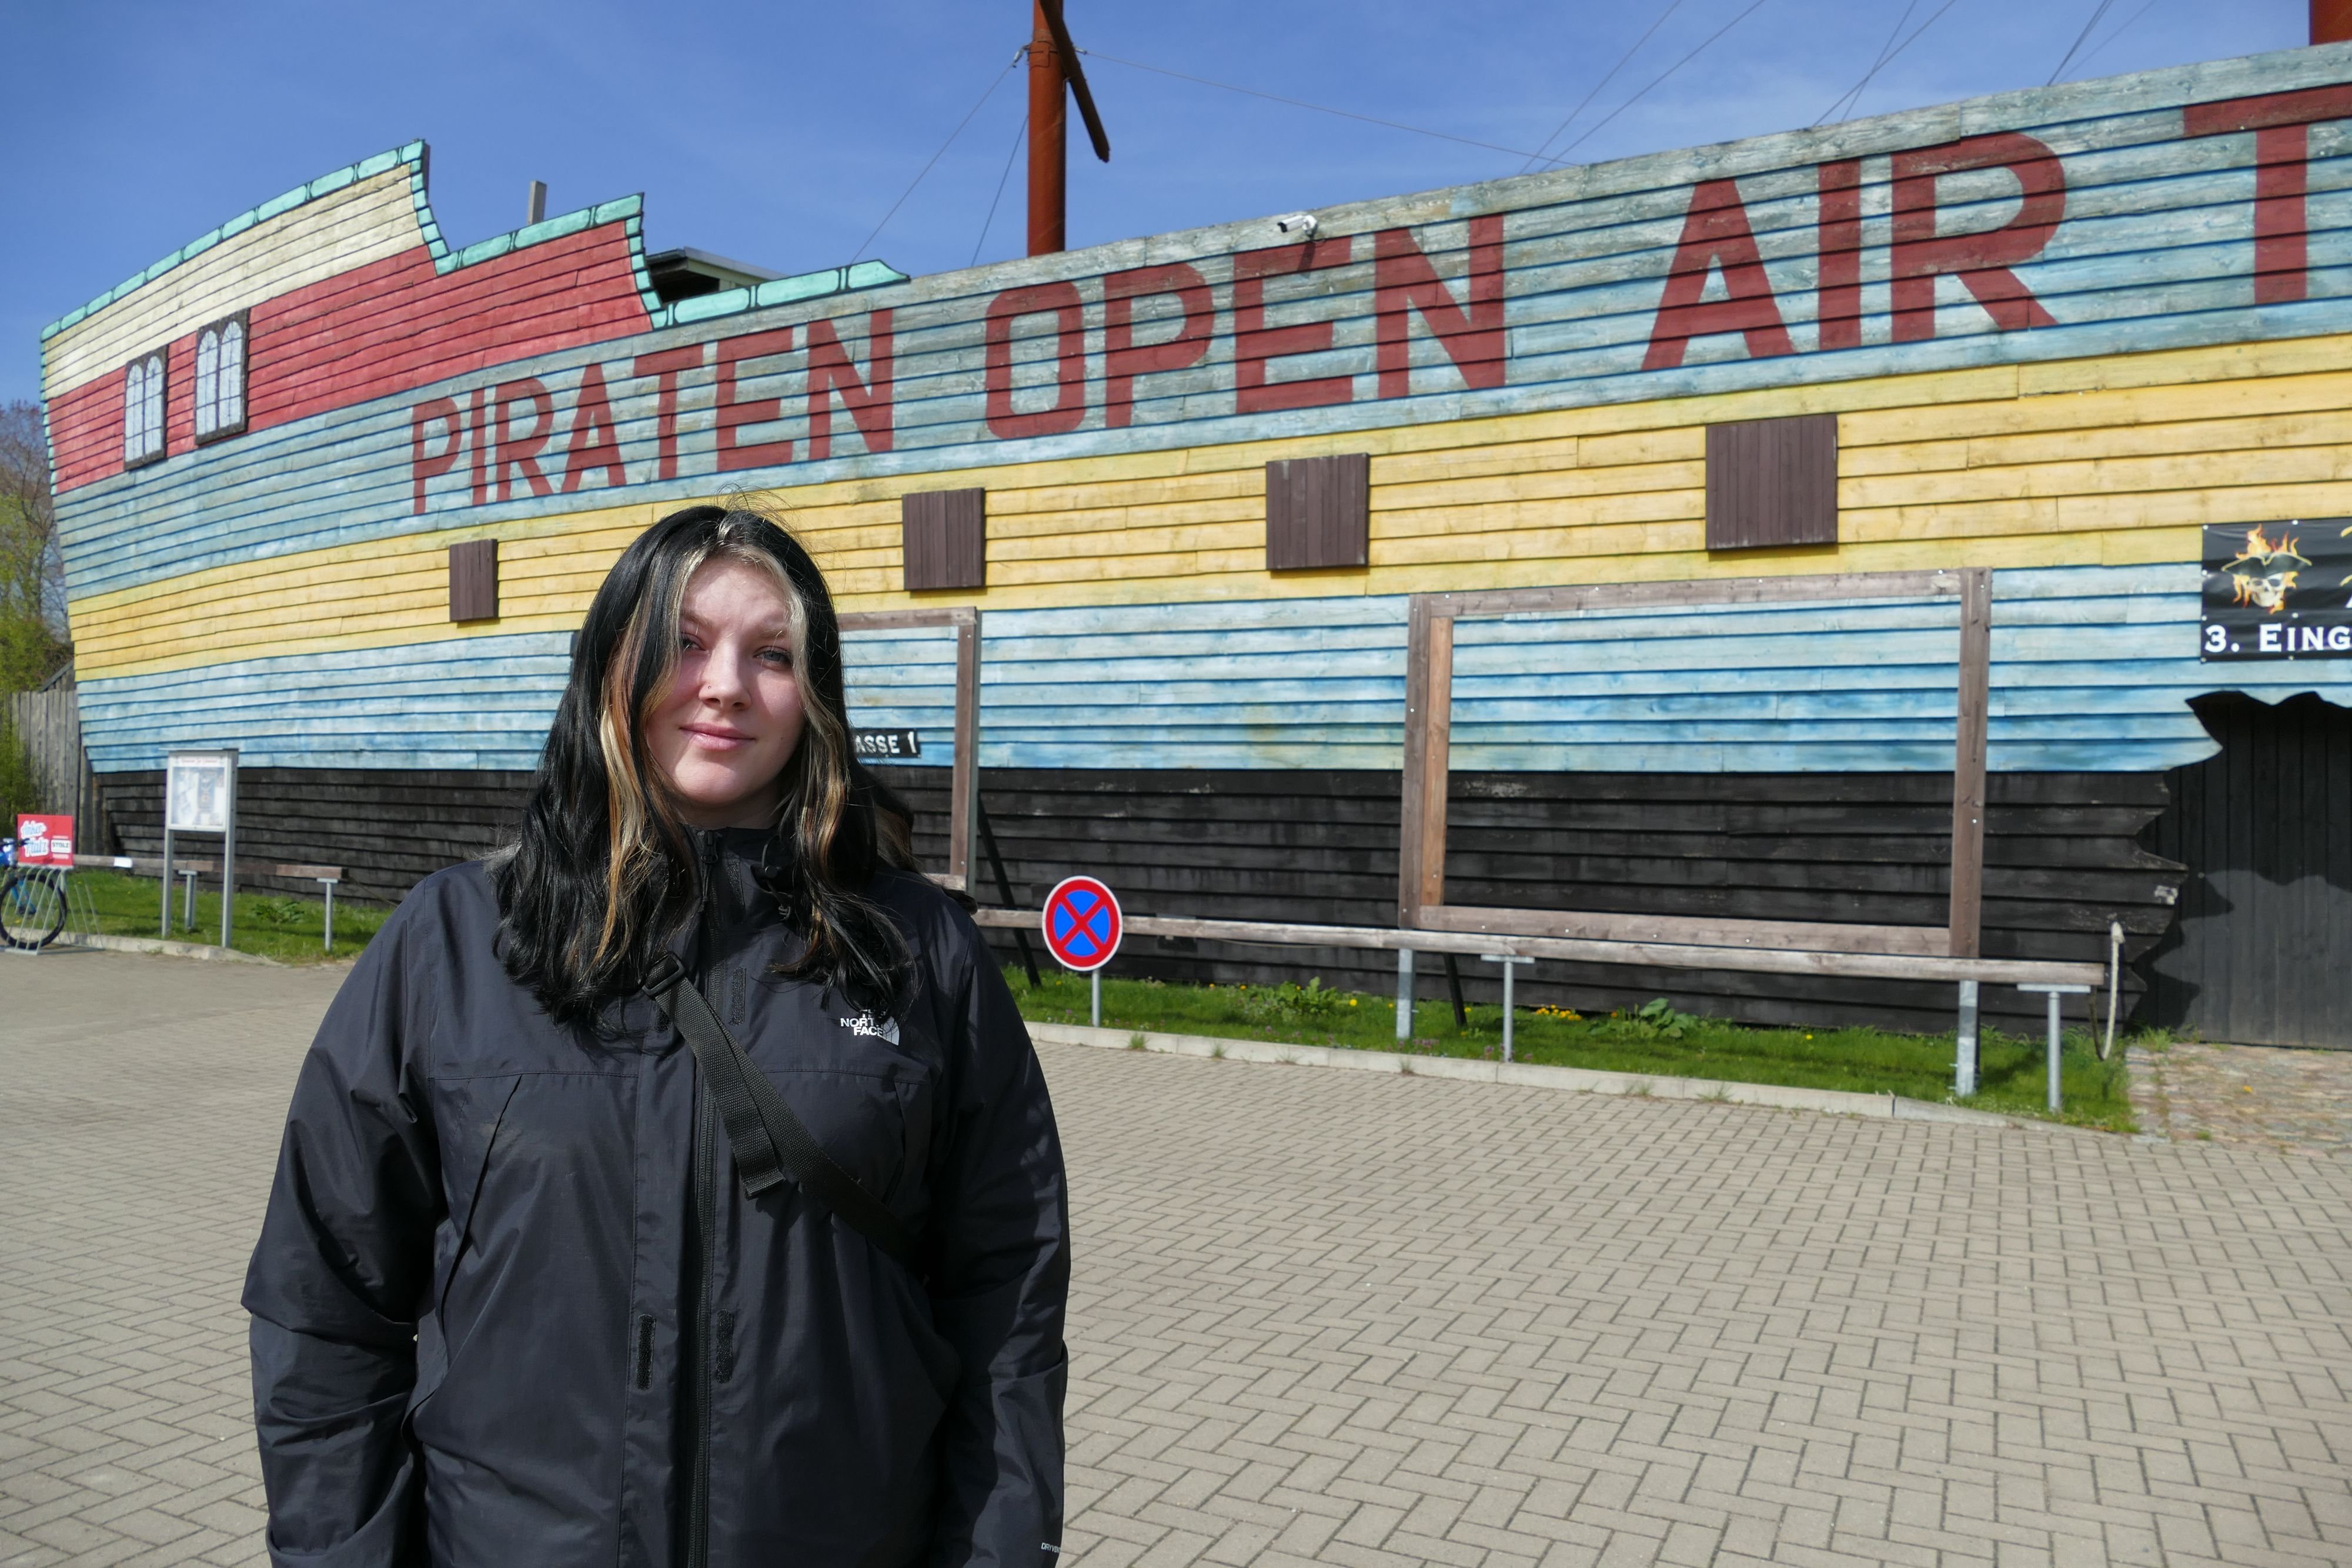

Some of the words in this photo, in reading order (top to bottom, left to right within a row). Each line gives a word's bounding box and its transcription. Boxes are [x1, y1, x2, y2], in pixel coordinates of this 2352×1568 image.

[412, 309, 893, 515] PIRATEN
[985, 213, 1504, 439] OPEN
[1641, 132, 2066, 371] AIR
[2184, 83, 2352, 305] T
[2206, 624, 2240, 653] 3.
[2260, 623, 2352, 652] EING
[908, 731, 917, 754] 1
[840, 1017, 883, 1028] NORT
[853, 1026, 884, 1038] FACE
